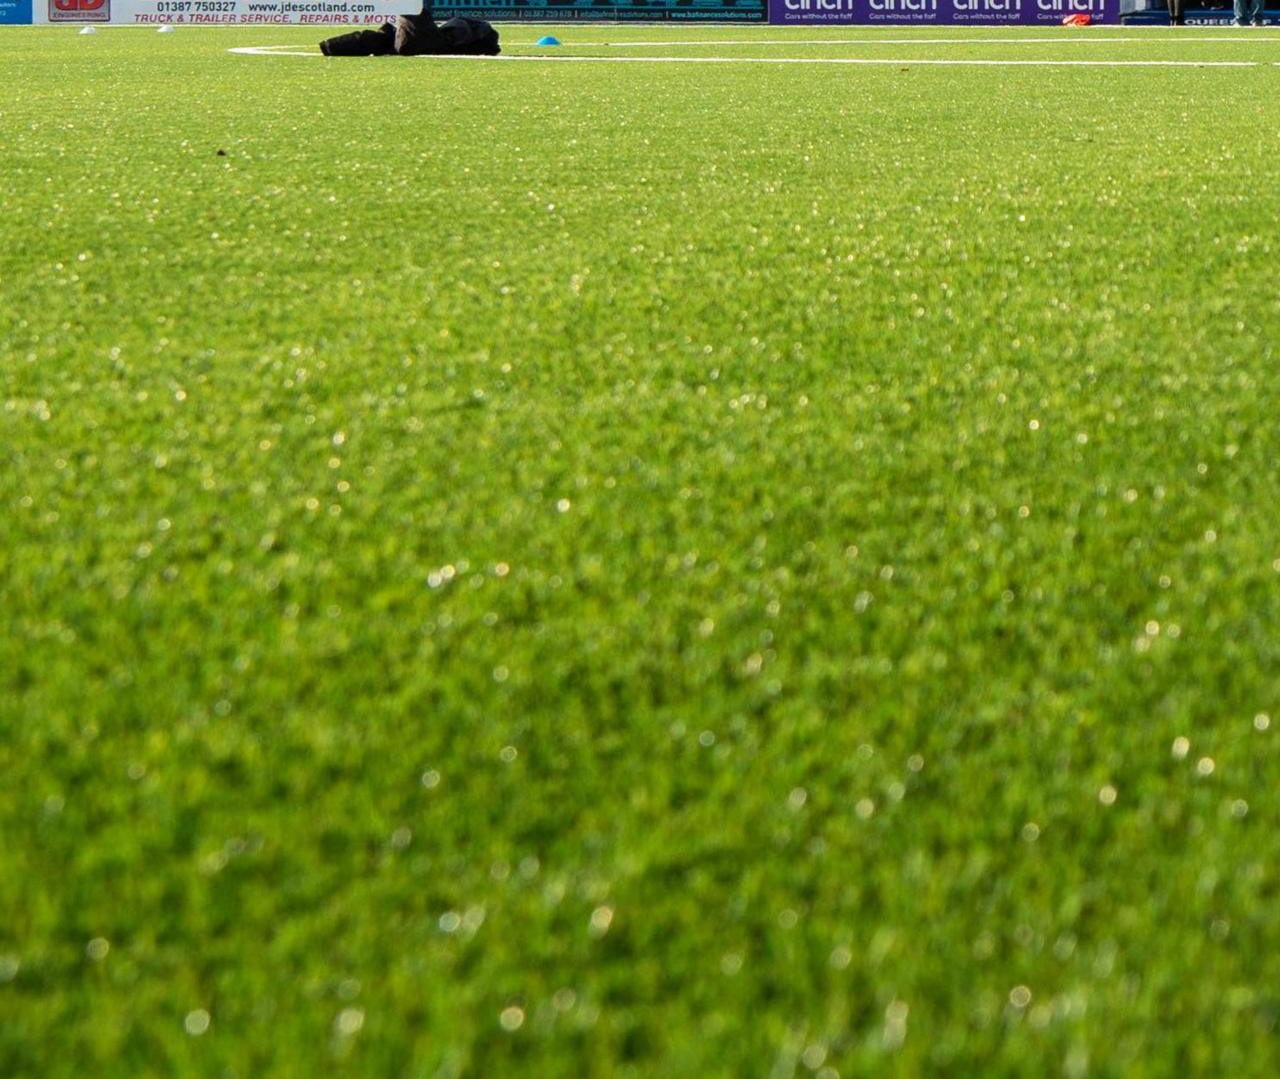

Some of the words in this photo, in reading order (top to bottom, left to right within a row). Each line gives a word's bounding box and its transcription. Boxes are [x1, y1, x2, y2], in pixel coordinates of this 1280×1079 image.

[157, 2, 192, 12] 01387
[195, 2, 236, 12] 750327
[249, 2, 375, 14] www.jdescotland.com
[135, 14, 175, 24] TRUCK
[177, 14, 186, 23] &
[189, 14, 237, 24] TRAILER
[300, 14, 350, 24] REPAIRS
[352, 15, 360, 23] &
